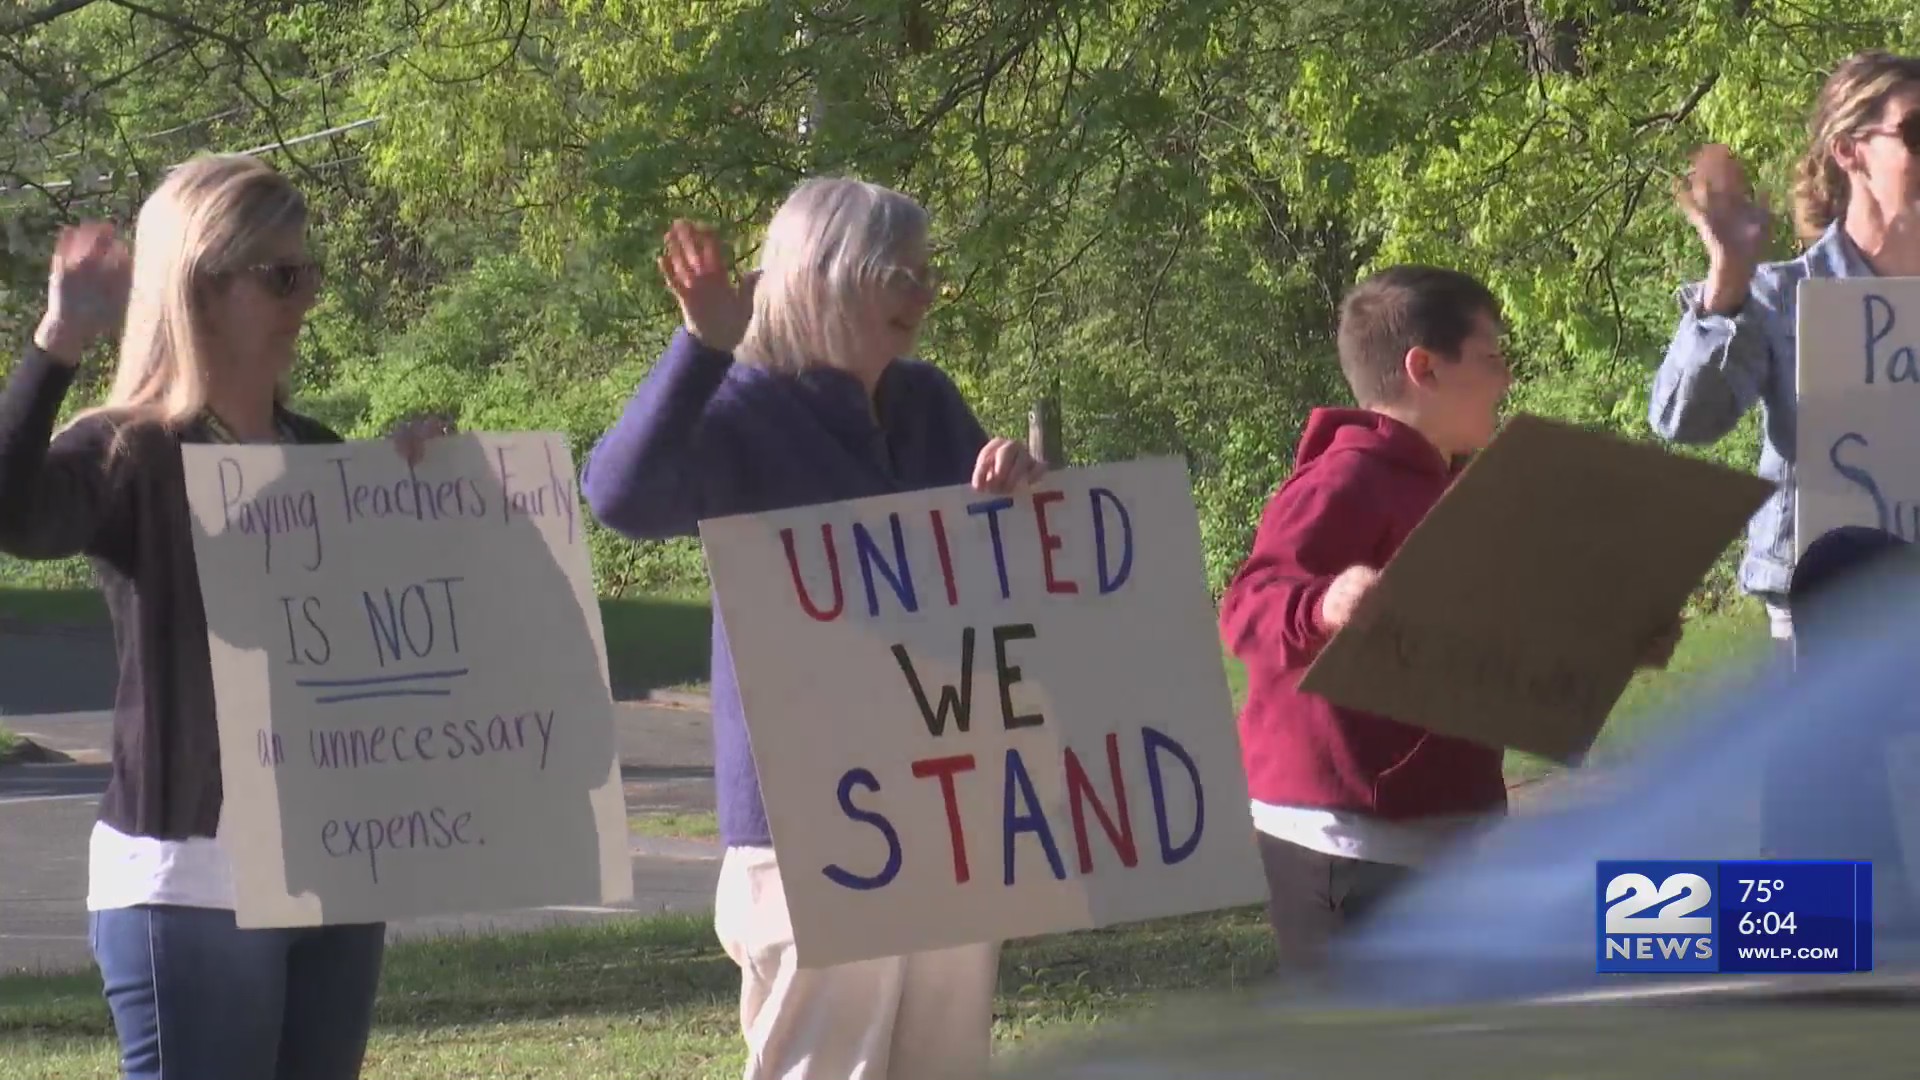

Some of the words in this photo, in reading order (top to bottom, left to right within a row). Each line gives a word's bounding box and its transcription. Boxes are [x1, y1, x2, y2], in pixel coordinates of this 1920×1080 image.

[217, 456, 323, 574] Paying
[325, 454, 488, 525] Teachers
[495, 440, 575, 545] Fairly
[779, 487, 1134, 622] UNITED
[280, 596, 332, 667] IS
[362, 576, 465, 668] NOT
[890, 622, 1045, 737] WE
[257, 727, 285, 768] an
[308, 709, 555, 769] unnecessary
[321, 805, 486, 884] expense.
[821, 726, 1205, 891] STAND
